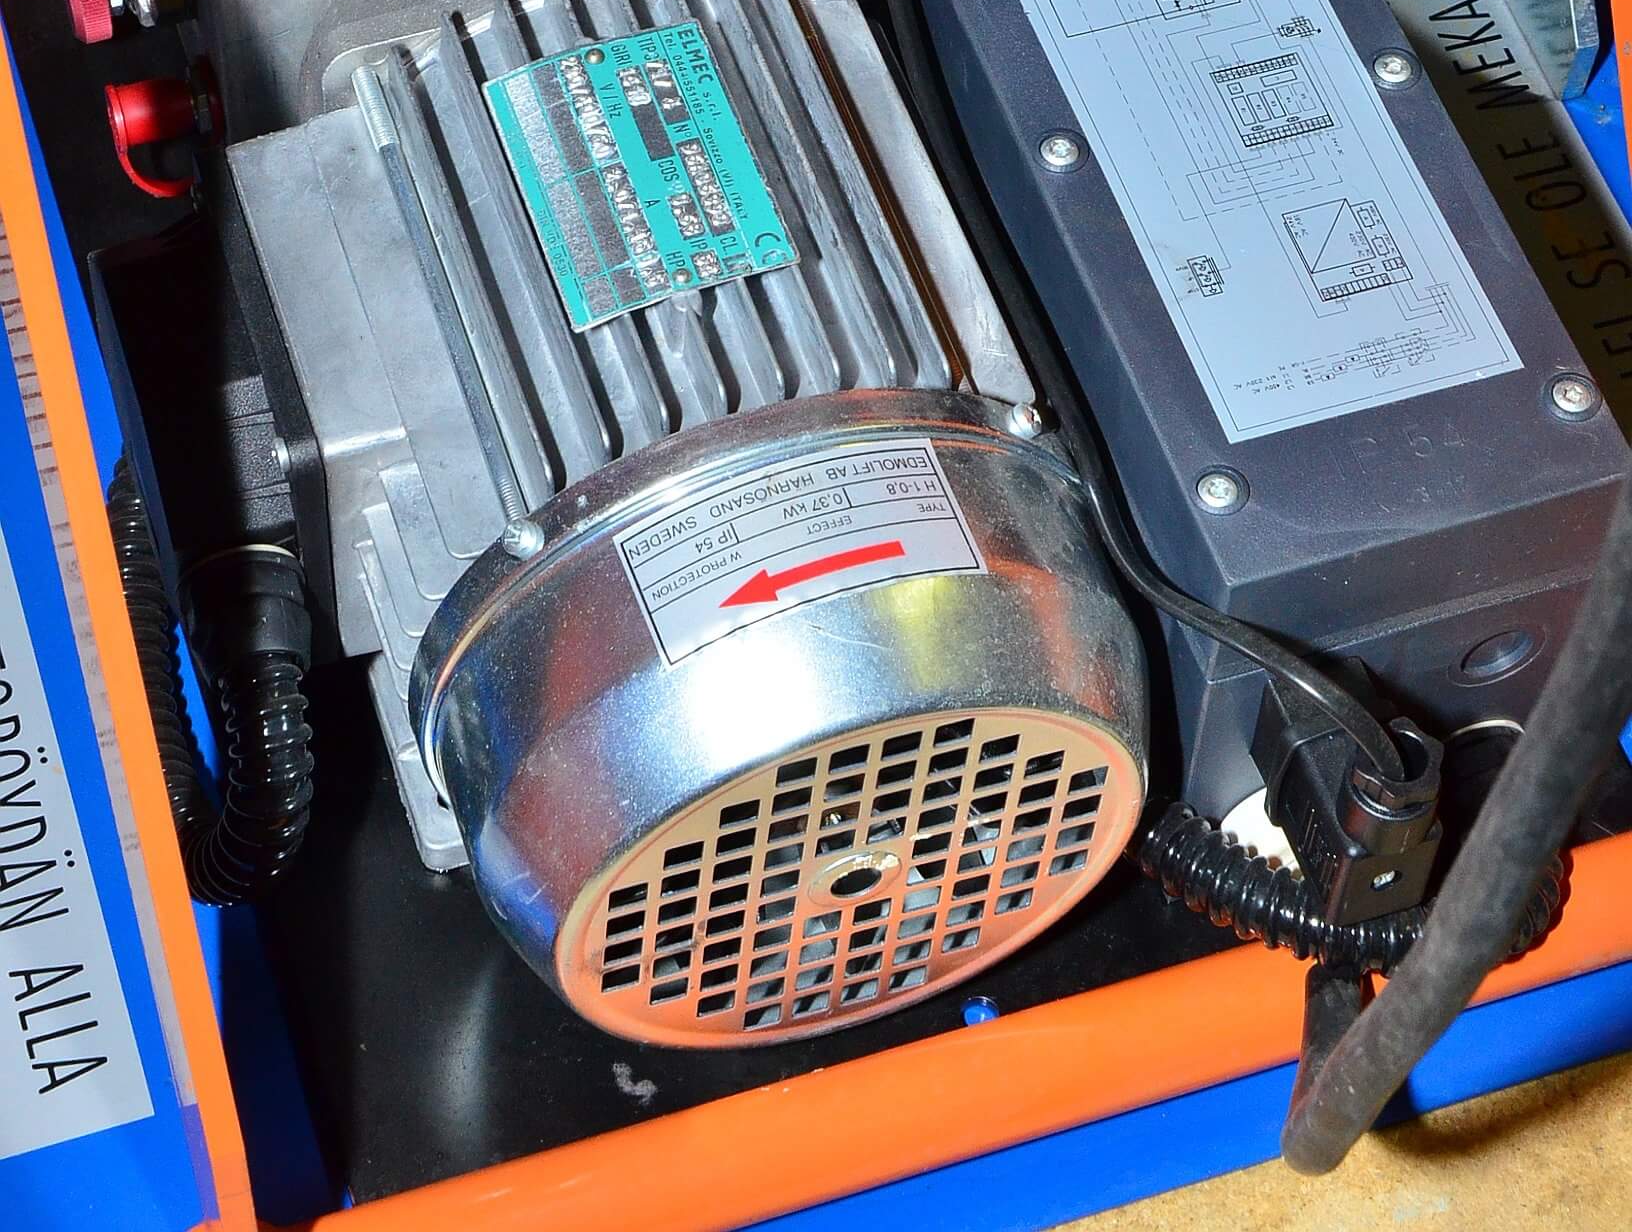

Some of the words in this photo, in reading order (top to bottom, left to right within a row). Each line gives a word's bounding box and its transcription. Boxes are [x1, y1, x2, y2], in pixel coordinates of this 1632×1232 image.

[676, 27, 715, 85] ELMEC
[702, 90, 722, 121] s.r.l.
[662, 32, 678, 51] Tel.
[702, 126, 726, 165] Sovizzo
[609, 42, 633, 68] GIRI
[657, 157, 680, 184] COS
[688, 236, 709, 254] IP
[1496, 136, 1587, 212] OLE
[643, 198, 658, 209] A
[552, 252, 568, 278] 0530
[665, 249, 687, 271] HP
[1552, 231, 1632, 289] SE
[823, 464, 848, 481] AB
[850, 453, 928, 476] EDMOLIFT
[884, 480, 922, 497] 1-0,8
[922, 479, 937, 491] H
[781, 501, 808, 521] kW
[809, 490, 843, 512] 0,37
[916, 500, 946, 512] TYPE
[805, 514, 853, 536] EFFECT
[627, 515, 698, 558] SWEDEN
[693, 535, 714, 554] 54
[716, 529, 734, 546] IP
[728, 550, 742, 563] W
[650, 556, 728, 601] PROTECTION
[8, 963, 108, 1094] ALLA
